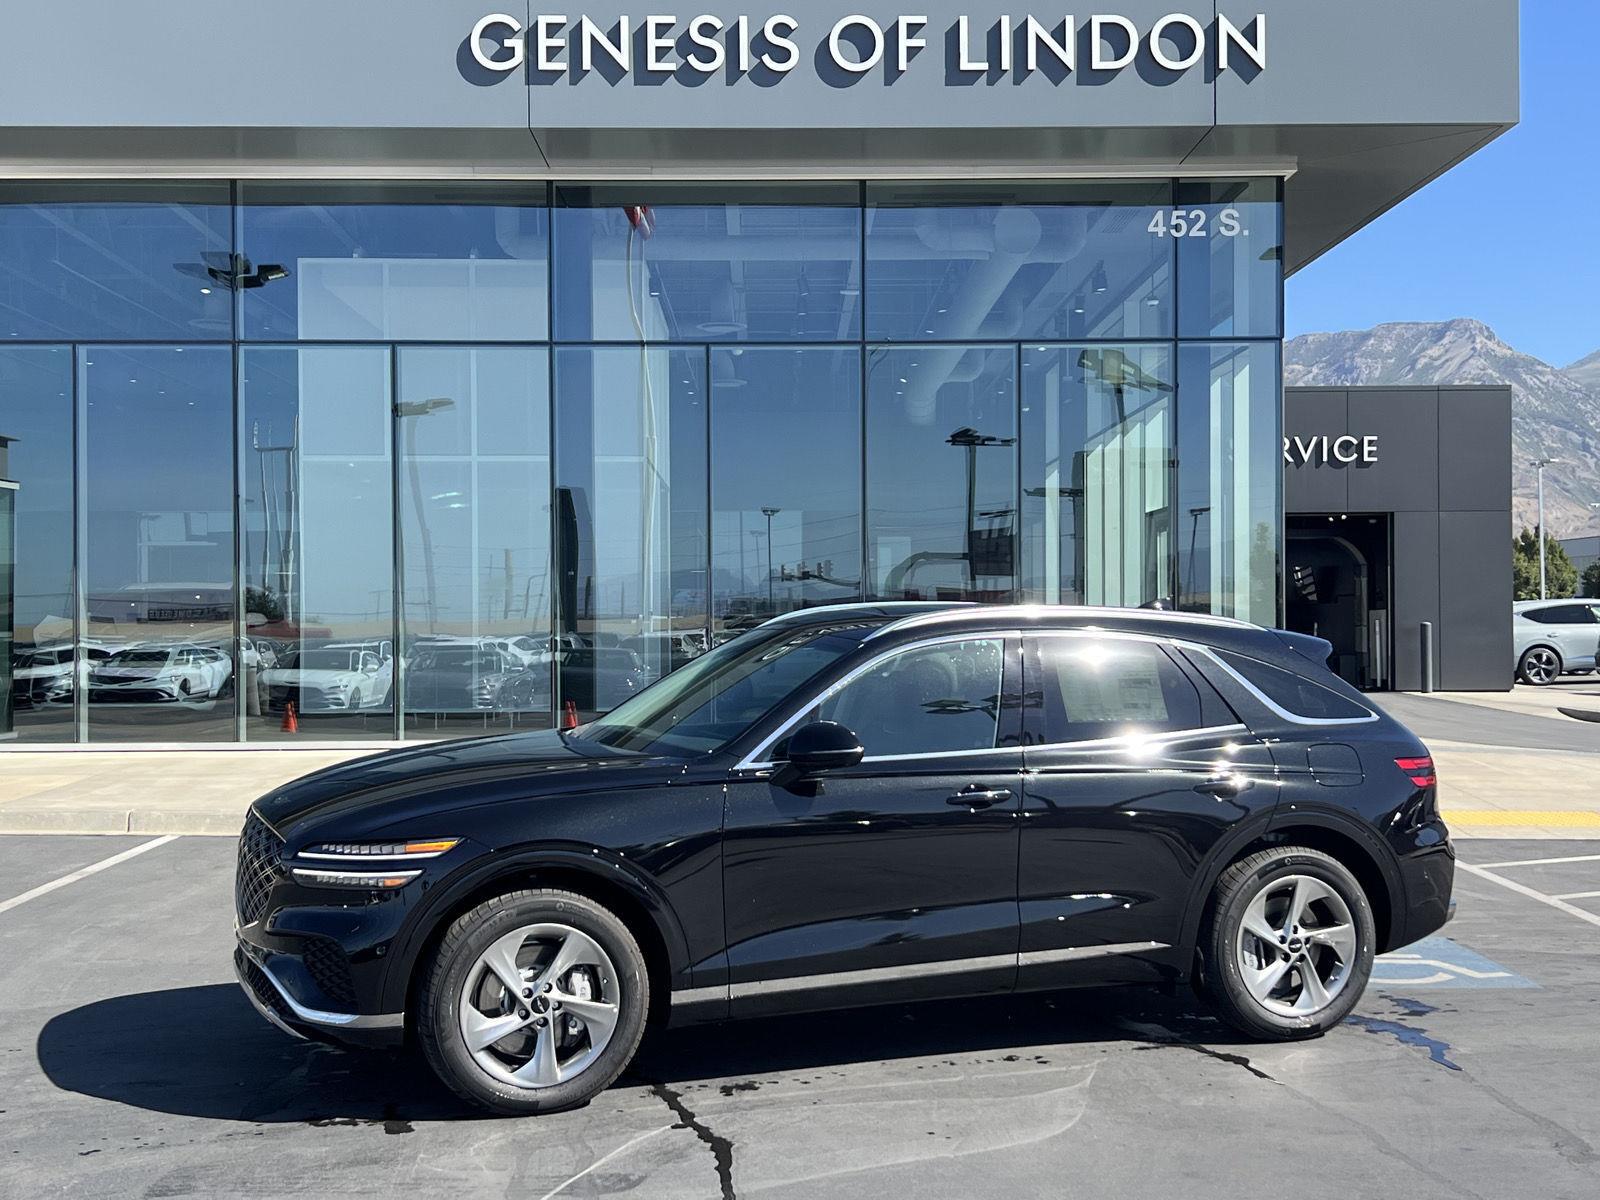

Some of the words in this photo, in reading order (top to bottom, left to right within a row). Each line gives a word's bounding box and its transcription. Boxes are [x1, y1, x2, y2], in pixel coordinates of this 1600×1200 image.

[470, 13, 800, 72] GENESIS
[829, 14, 928, 72] OF
[959, 13, 1266, 72] LINDON
[1147, 209, 1207, 238] 452
[1219, 208, 1249, 237] S.
